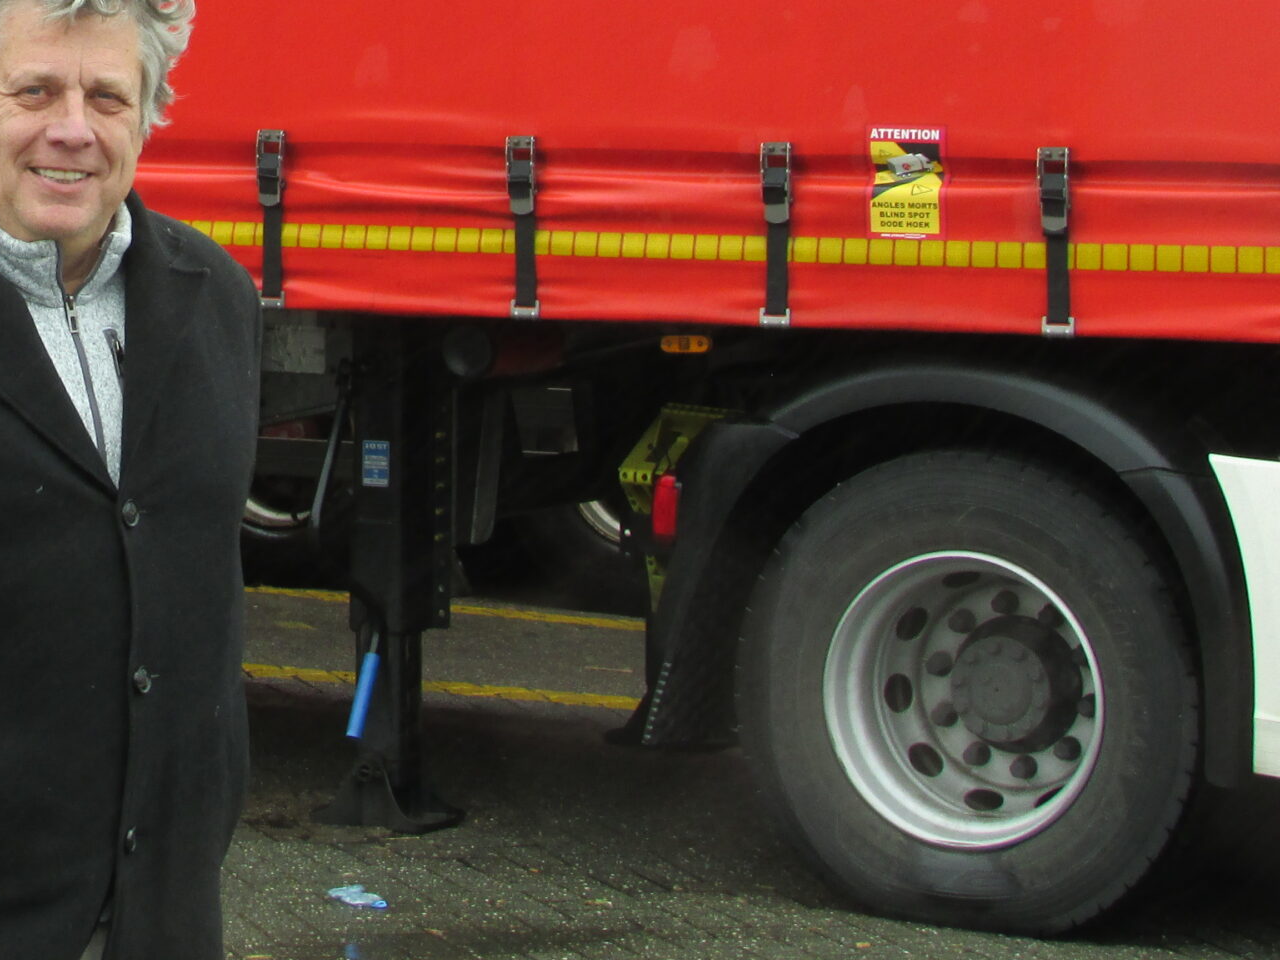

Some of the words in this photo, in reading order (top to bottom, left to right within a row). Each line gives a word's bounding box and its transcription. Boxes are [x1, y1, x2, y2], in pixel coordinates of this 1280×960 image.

[870, 128, 940, 140] ATTENTION
[907, 202, 938, 210] MORTS
[908, 211, 931, 219] SPOT
[880, 220, 904, 228] DODE
[906, 221, 930, 229] HOEK
